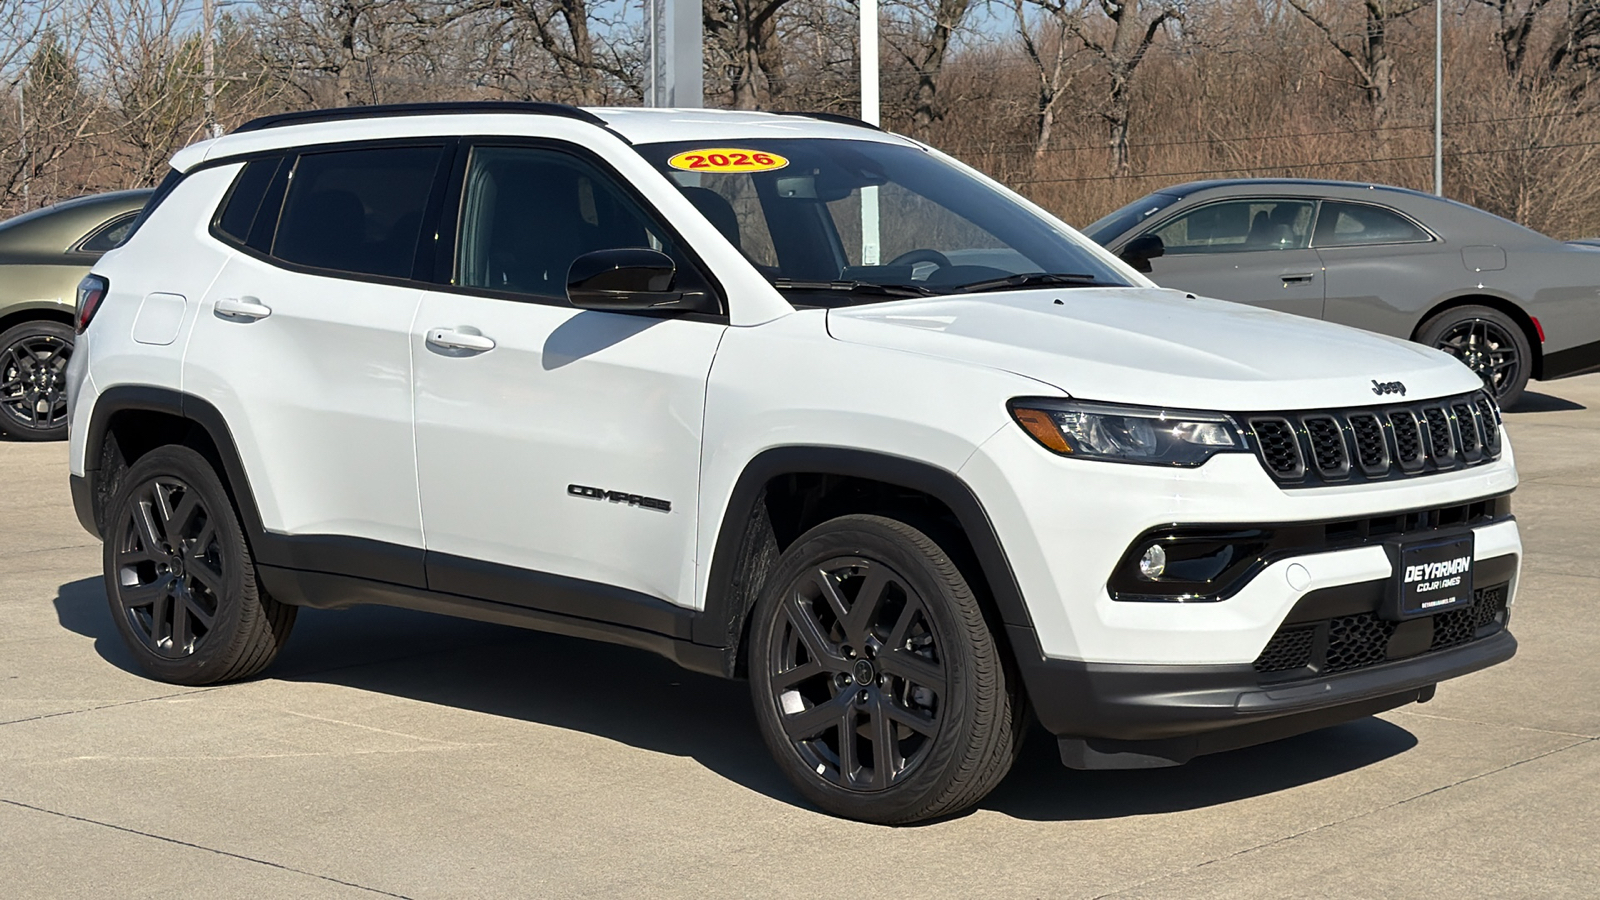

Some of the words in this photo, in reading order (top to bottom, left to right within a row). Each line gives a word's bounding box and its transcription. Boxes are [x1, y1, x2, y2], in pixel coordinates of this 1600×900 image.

[685, 153, 774, 169] 2026
[1371, 379, 1407, 397] Jeep
[567, 483, 672, 513] COMPASS
[1404, 556, 1471, 583] DEYARMAN
